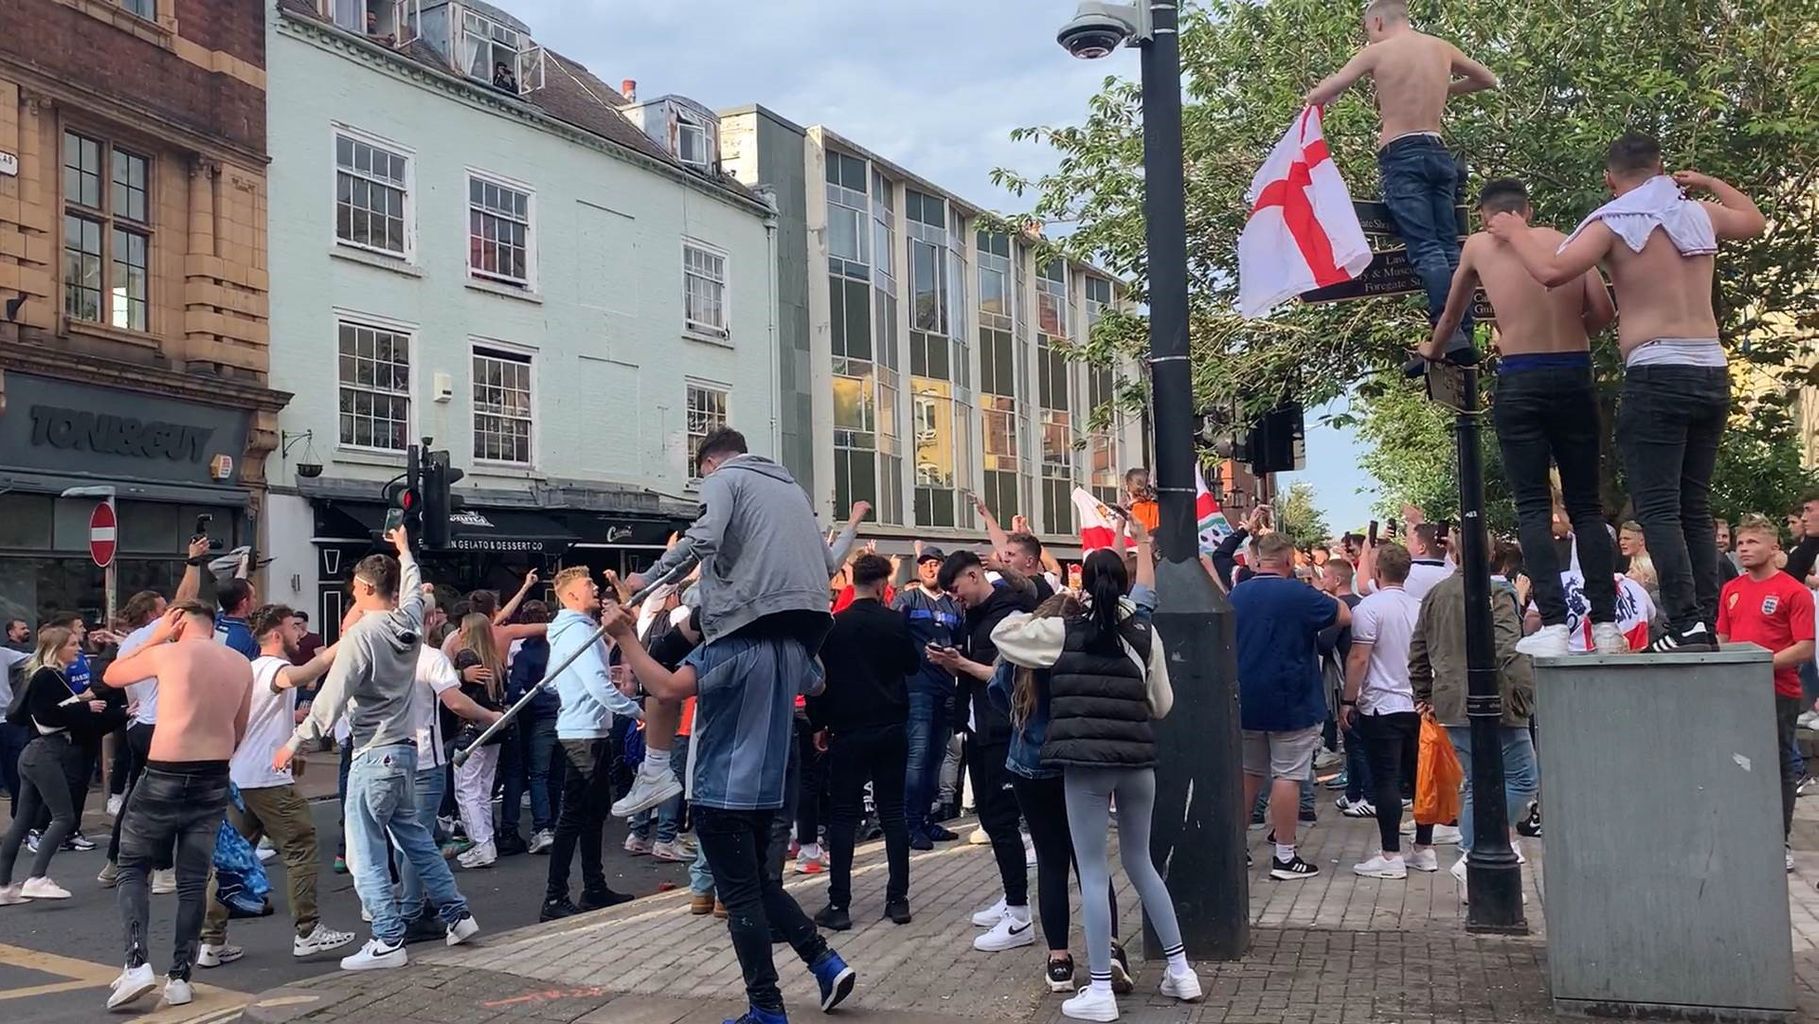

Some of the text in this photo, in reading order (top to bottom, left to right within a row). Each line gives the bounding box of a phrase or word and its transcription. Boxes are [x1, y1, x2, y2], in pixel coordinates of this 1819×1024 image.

[1384, 266, 1416, 278] Museu
[1365, 279, 1406, 292] Foregate
[459, 540, 489, 549] GELATO
[490, 541, 496, 550] &
[496, 541, 531, 550] DESSERT
[531, 542, 543, 551] CO
[863, 780, 874, 812] FILA
